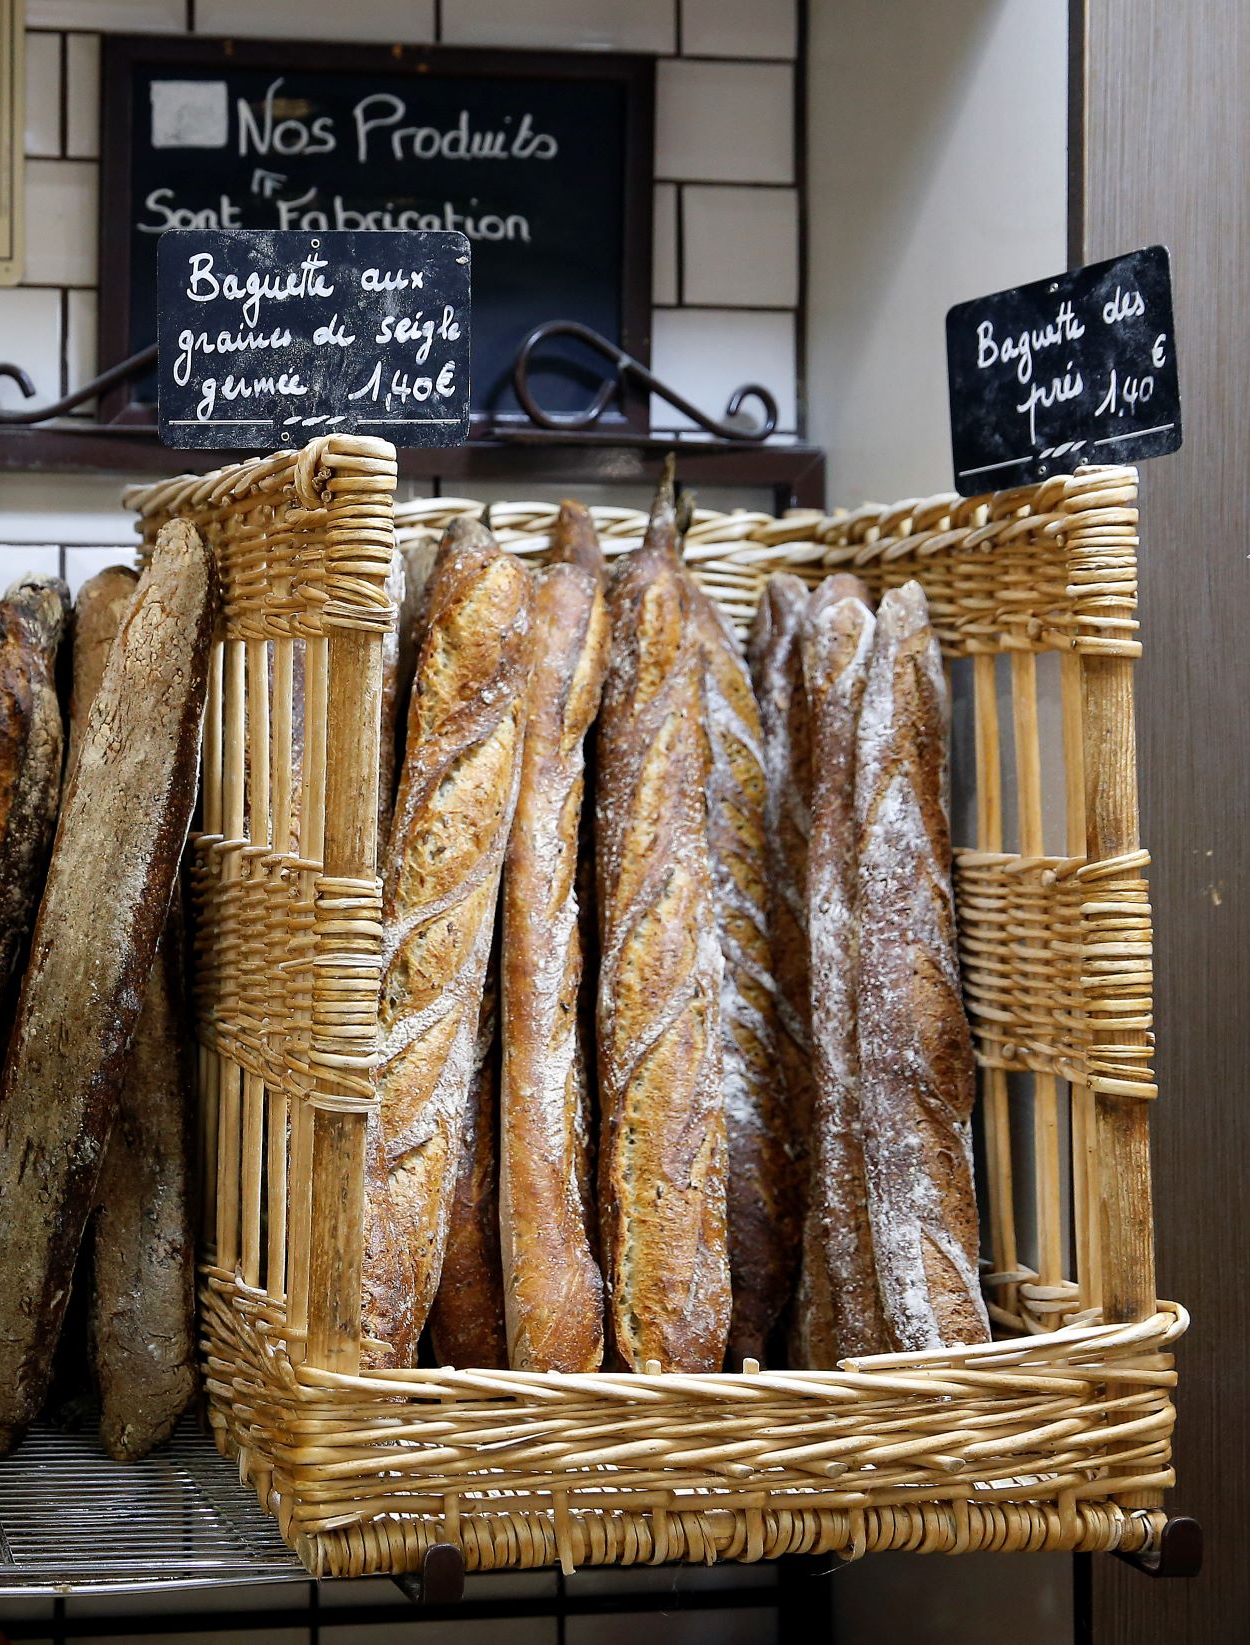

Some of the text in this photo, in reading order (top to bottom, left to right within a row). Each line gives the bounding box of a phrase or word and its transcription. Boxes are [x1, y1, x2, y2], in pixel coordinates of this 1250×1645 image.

[237, 77, 558, 162] Nos Produits
[137, 186, 531, 243] Sont Fabrication
[186, 253, 423, 328] Baguette aux
[173, 304, 460, 386] graines de seigle
[977, 286, 1146, 384] Baguette des
[196, 367, 307, 421] germée
[1017, 361, 1084, 445] prés
[1152, 334, 1167, 368] €
